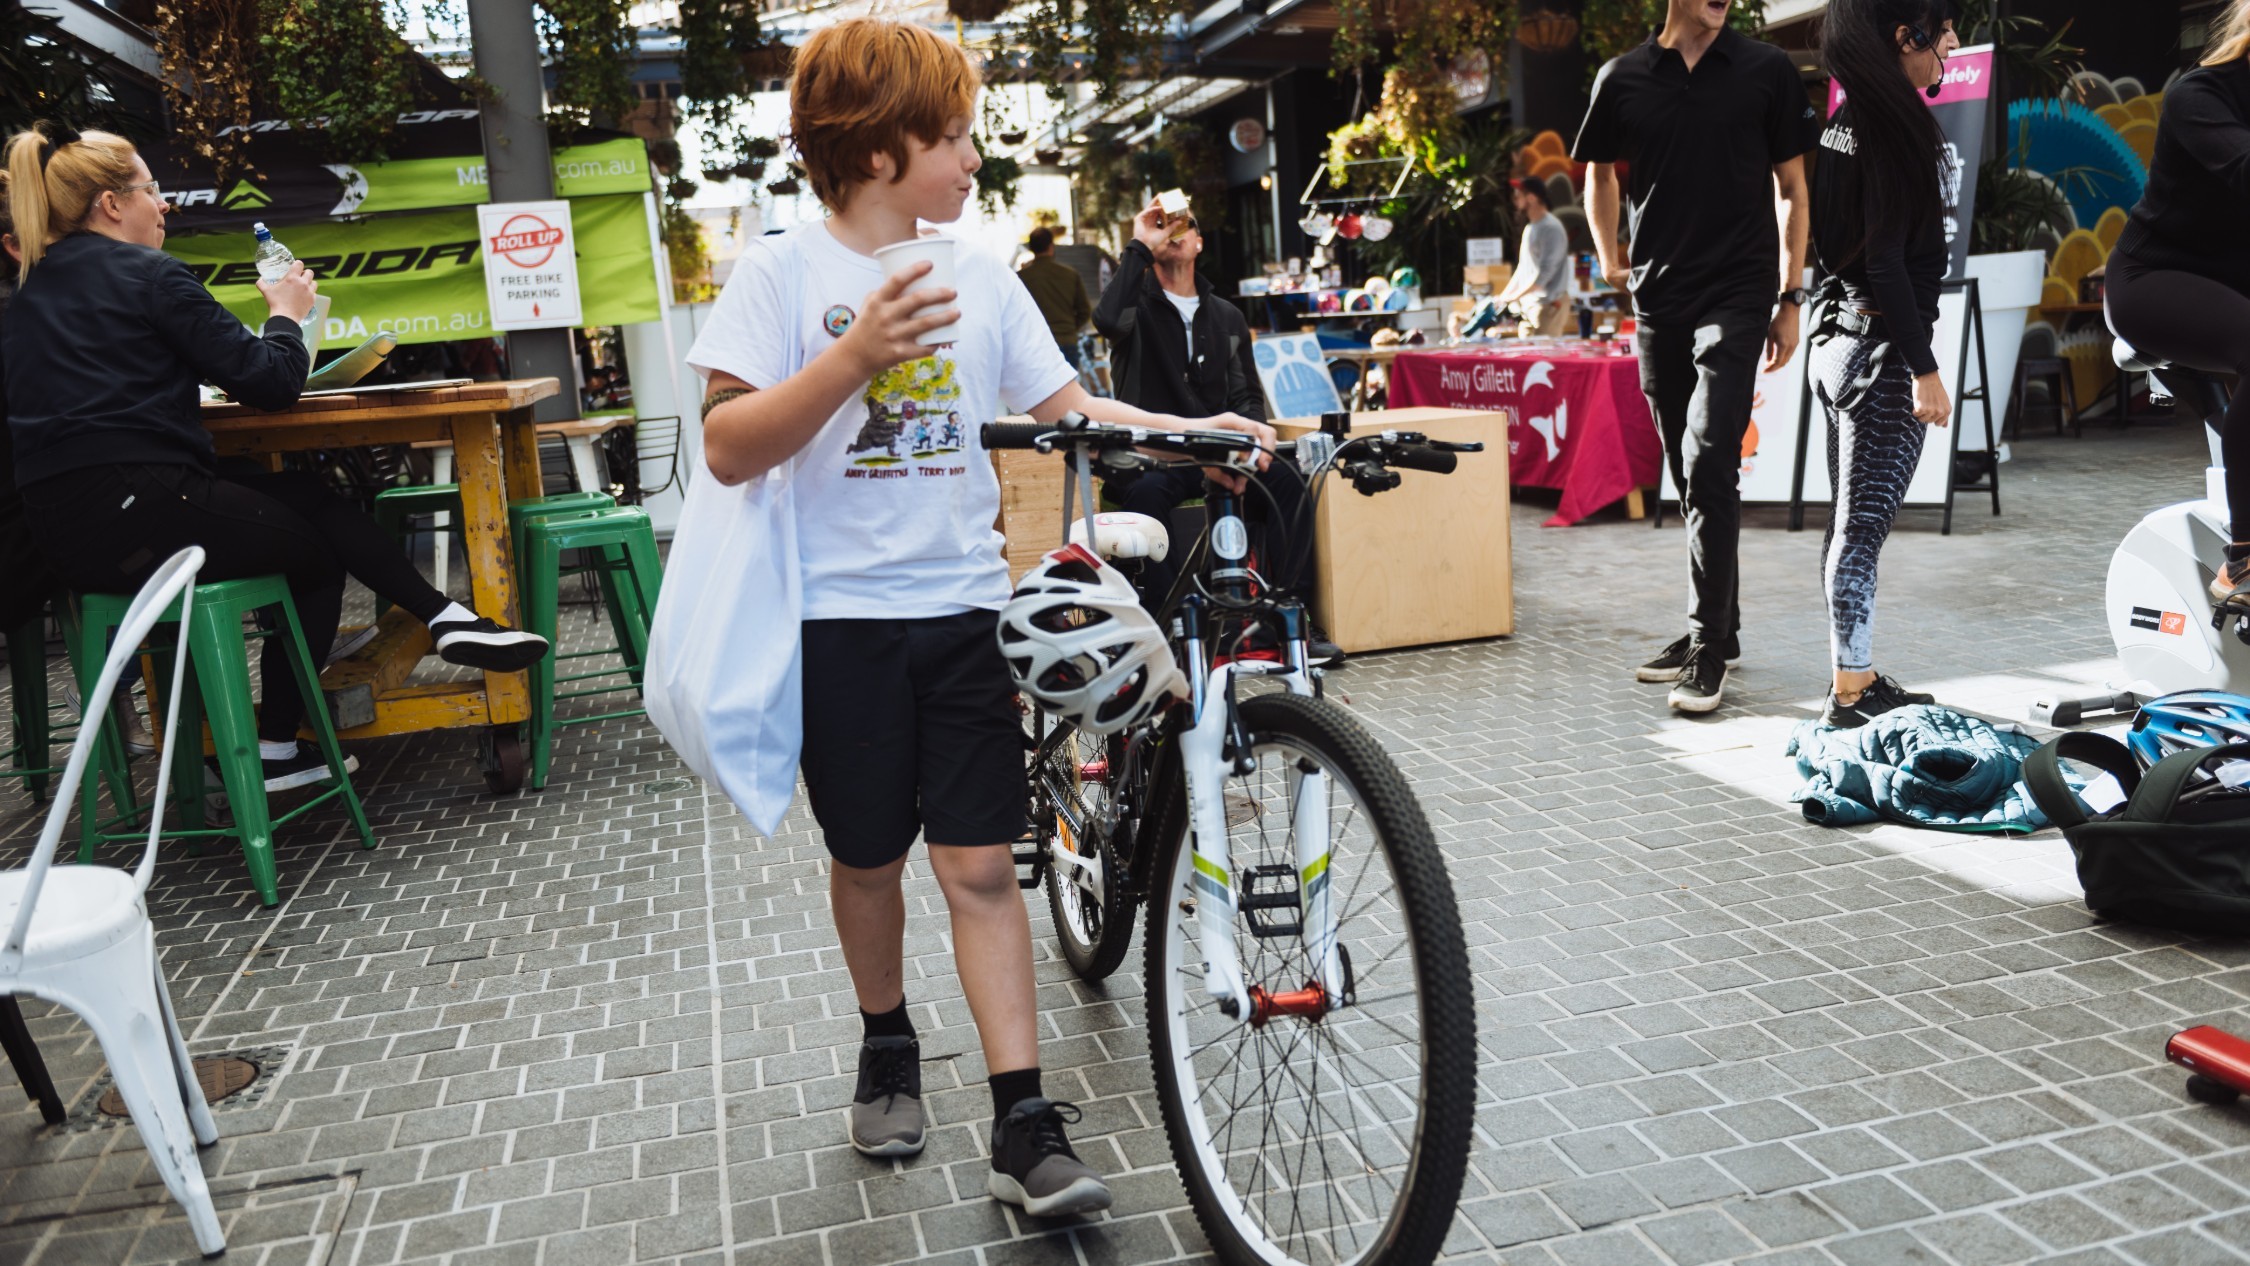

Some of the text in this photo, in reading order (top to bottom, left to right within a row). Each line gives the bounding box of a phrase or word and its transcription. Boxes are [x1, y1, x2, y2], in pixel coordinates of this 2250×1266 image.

[1937, 65, 1982, 85] afely
[497, 231, 559, 250] ROLL UP
[501, 273, 563, 286] FREE BIKE
[507, 288, 560, 300] PARKING
[1441, 364, 1517, 398] Amy Gillett
